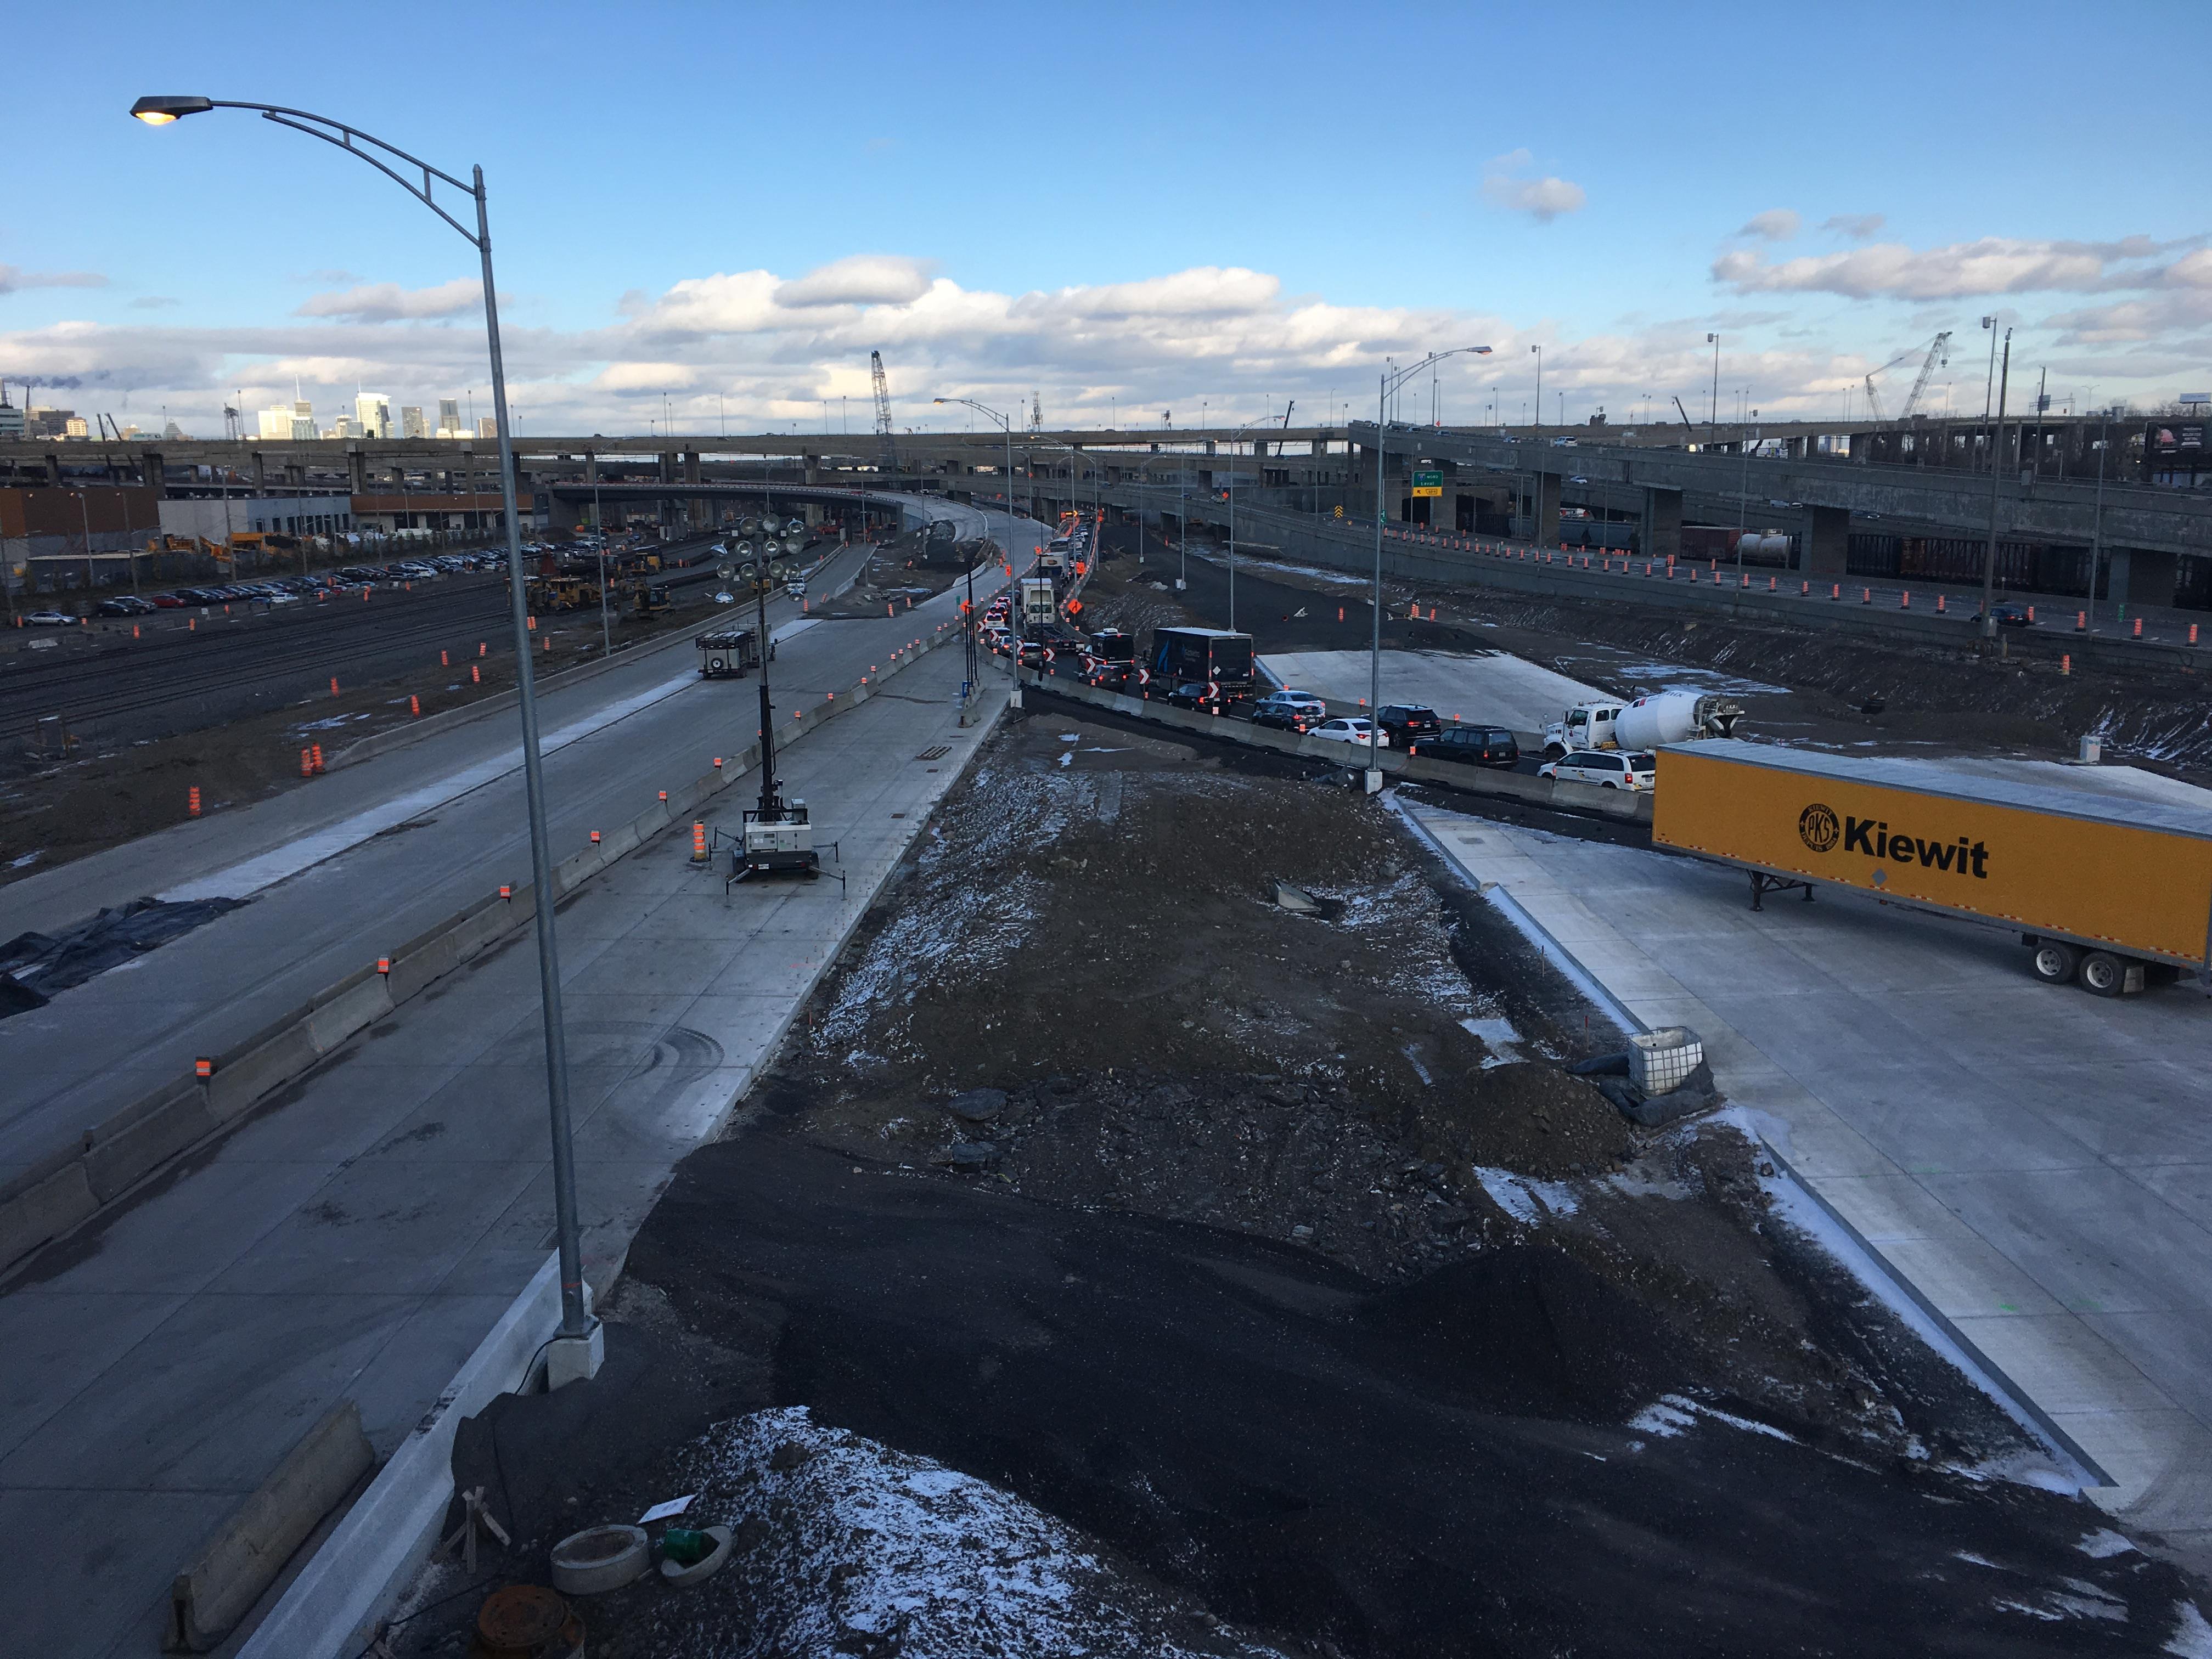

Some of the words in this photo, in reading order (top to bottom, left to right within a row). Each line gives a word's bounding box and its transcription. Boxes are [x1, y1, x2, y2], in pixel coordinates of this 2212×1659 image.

[1808, 804, 1833, 816] KIEWIT
[1808, 812, 1831, 843] PKS
[1844, 816, 1989, 879] Kiewit
